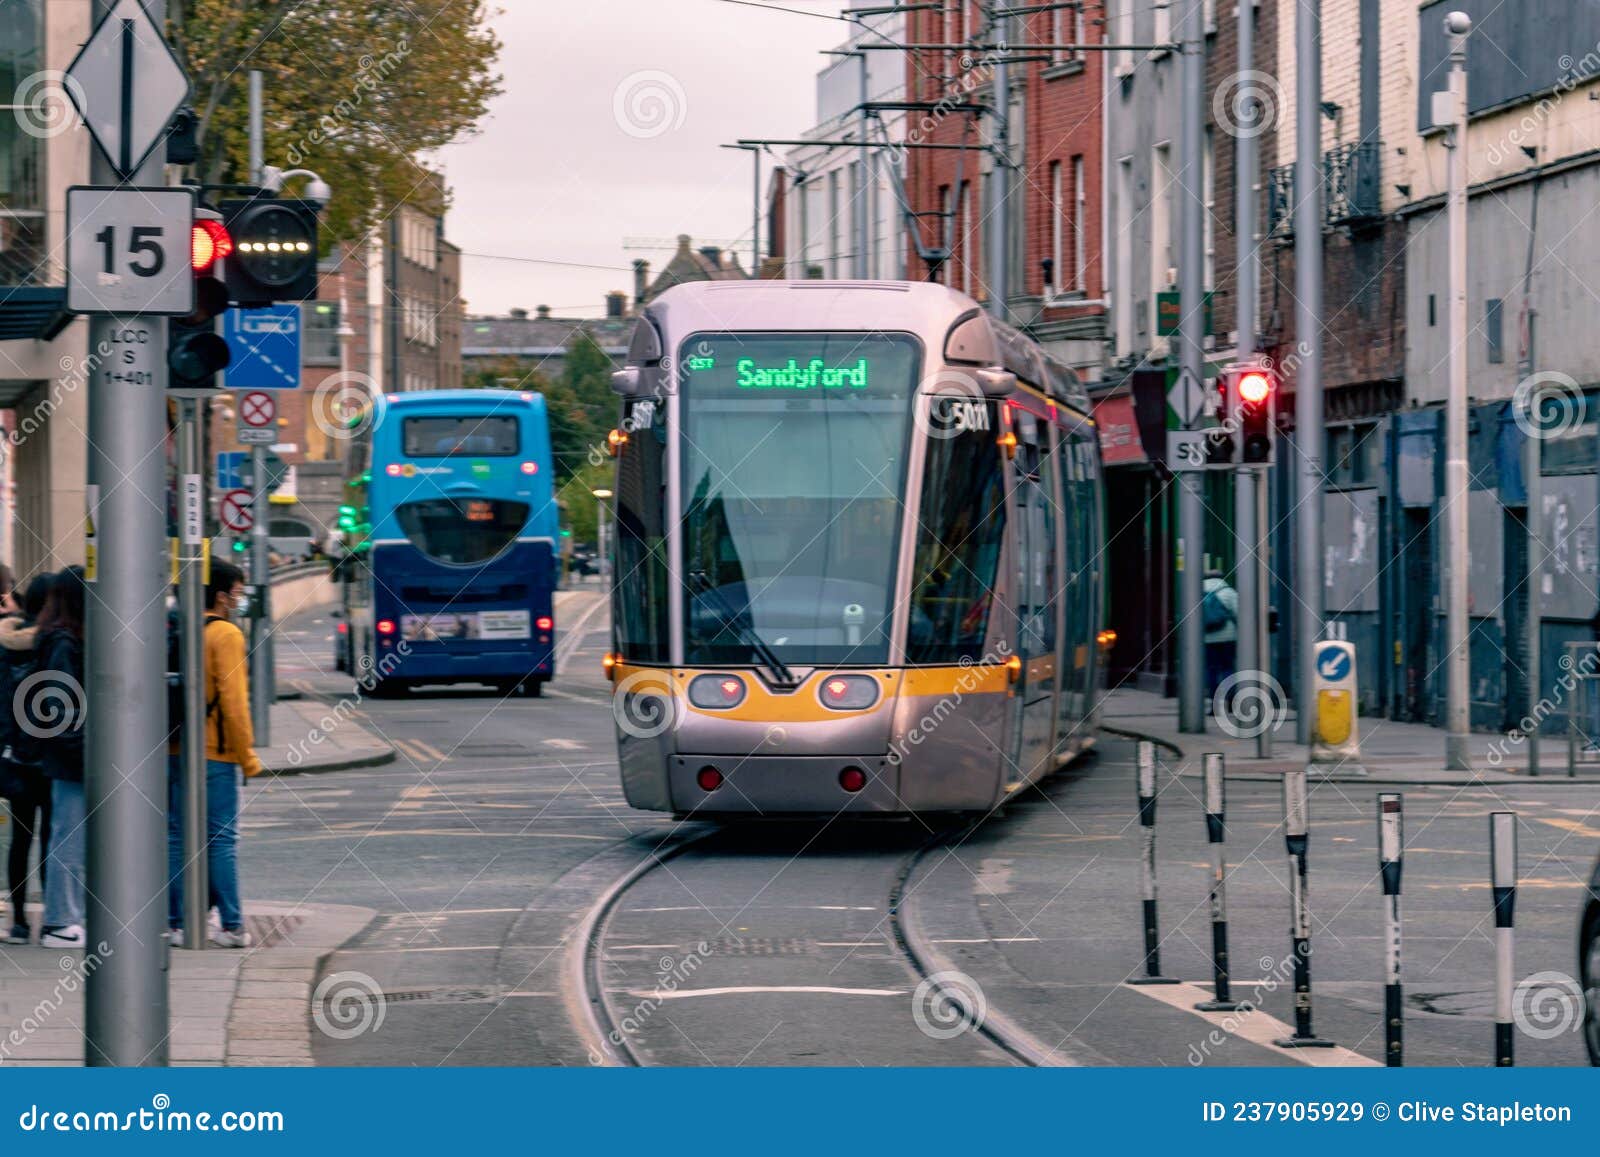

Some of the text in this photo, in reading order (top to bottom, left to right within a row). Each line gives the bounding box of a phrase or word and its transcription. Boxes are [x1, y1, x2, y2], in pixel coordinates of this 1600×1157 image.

[96, 226, 164, 278] 15
[111, 330, 149, 344] LCC
[123, 351, 136, 364] S
[737, 358, 867, 388] Sandyford
